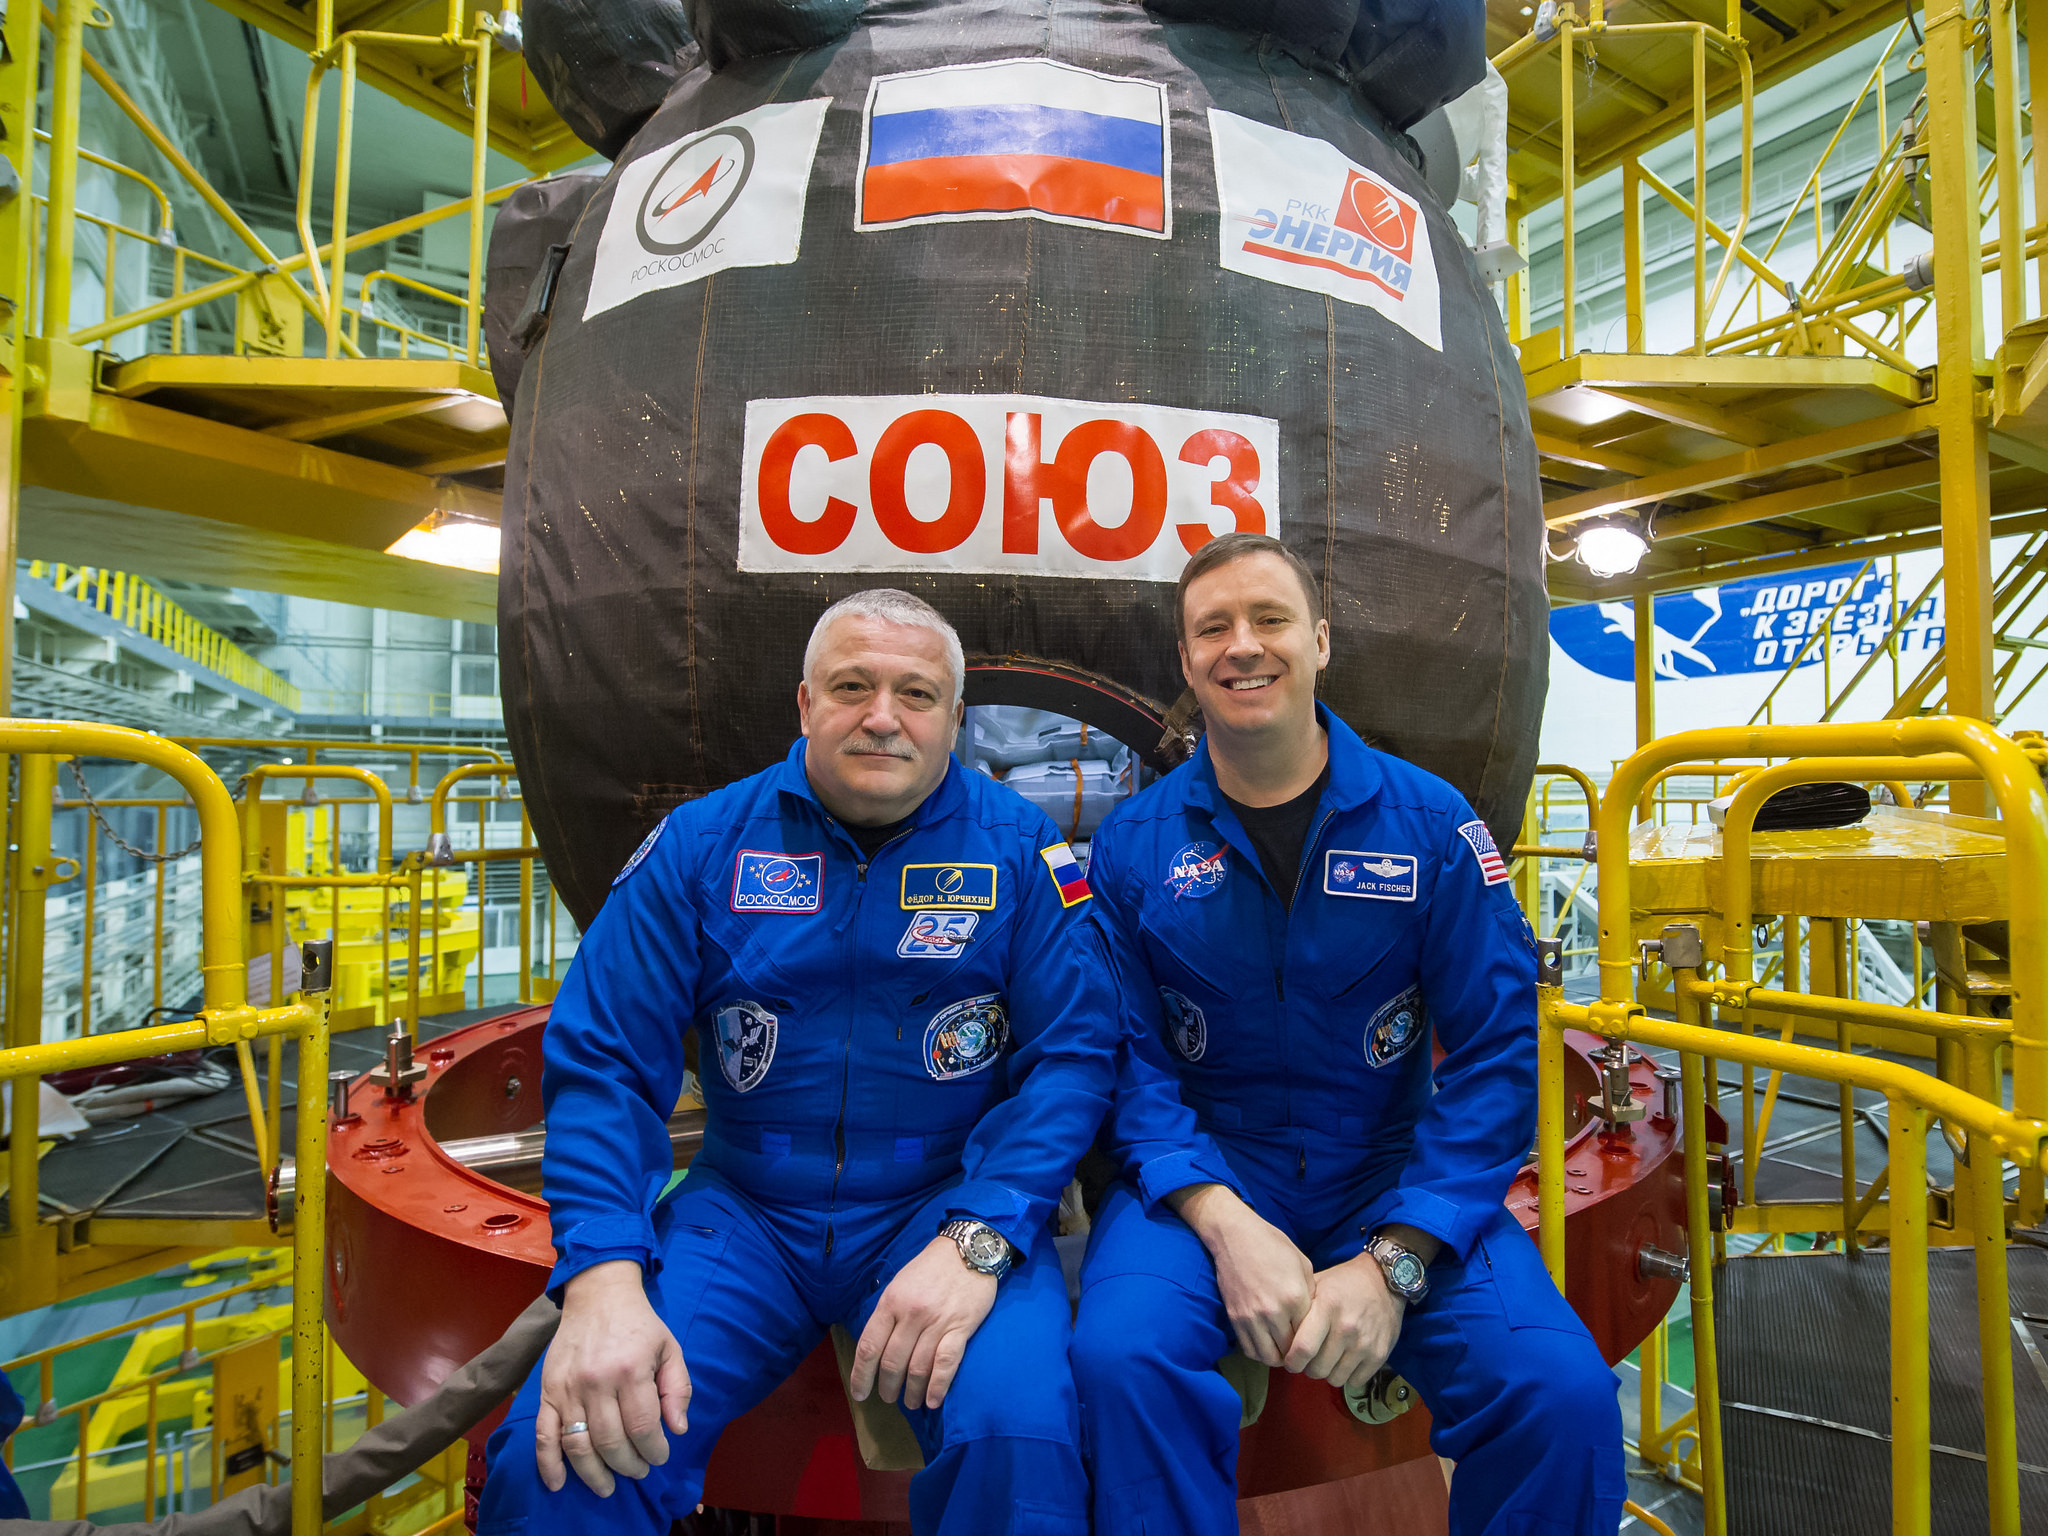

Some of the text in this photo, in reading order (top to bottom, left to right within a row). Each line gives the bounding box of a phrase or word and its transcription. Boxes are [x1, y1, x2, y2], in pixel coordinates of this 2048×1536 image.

[1286, 198, 1331, 222] РКК
[630, 237, 726, 285] РОСКОСМОС
[1247, 208, 1413, 292] ЭНЕРГИЯ
[757, 409, 1267, 562] СОЮЗ
[1753, 613, 1779, 640] К
[1173, 859, 1225, 879] NASA
[738, 894, 816, 906] РОСКОСМОС
[906, 893, 934, 905] ФЁДОР
[947, 894, 990, 905] ЮРЧИХИН
[1356, 882, 1411, 894] JACK FISCHER
[906, 916, 967, 952] 25
